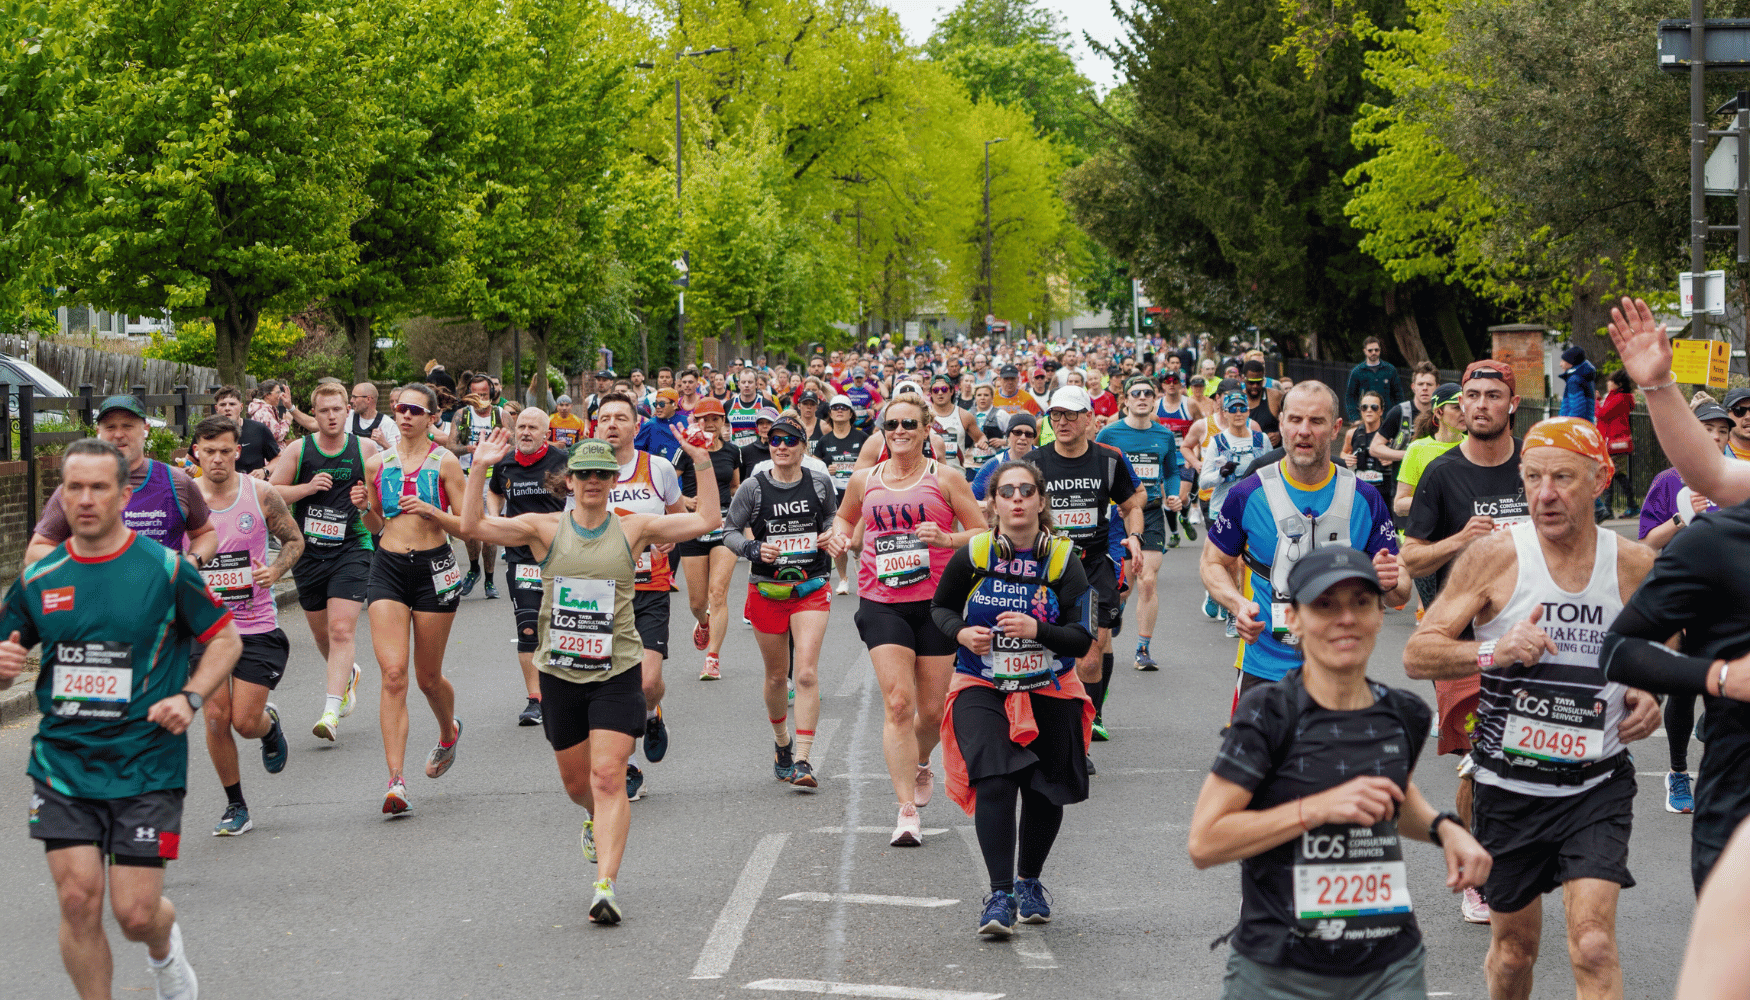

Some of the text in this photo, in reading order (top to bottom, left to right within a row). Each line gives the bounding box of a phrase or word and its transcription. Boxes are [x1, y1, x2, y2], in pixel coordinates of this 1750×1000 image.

[1046, 478, 1102, 492] ANDREW
[773, 499, 810, 517] INGE
[1051, 495, 1069, 508] tcs
[1474, 500, 1499, 516] tcs
[124, 511, 167, 519] Meningitis
[308, 506, 323, 517] tcs
[872, 502, 927, 532] KYSA
[1057, 511, 1092, 526] 17423
[124, 519, 163, 527] Research
[310, 521, 339, 536] 17489
[768, 522, 787, 534] tcs
[775, 537, 811, 551] 21712
[876, 538, 896, 551] tcs
[431, 558, 450, 572] tcs
[884, 553, 922, 574] 20046
[993, 558, 1038, 577] ZOE
[207, 571, 244, 587] 23881
[993, 580, 1028, 595] Brain
[973, 591, 1028, 609] Research
[553, 613, 577, 628] tcs
[1541, 602, 1603, 625] TOM
[559, 635, 603, 655] 22915
[996, 633, 1021, 650] tcs
[57, 643, 85, 664] tcs
[1004, 653, 1045, 673] 19457
[64, 675, 117, 695] 24892
[1019, 684, 1030, 692] new
[1030, 680, 1050, 690] balance
[1515, 696, 1576, 717] tcs TATA
[1551, 712, 1584, 724] SERVICES
[1518, 725, 1588, 759] 20495
[1302, 827, 1374, 859] tcs TATA
[1347, 847, 1385, 858] SERVICES
[1316, 873, 1393, 905] 22295
[1344, 926, 1364, 940] new
